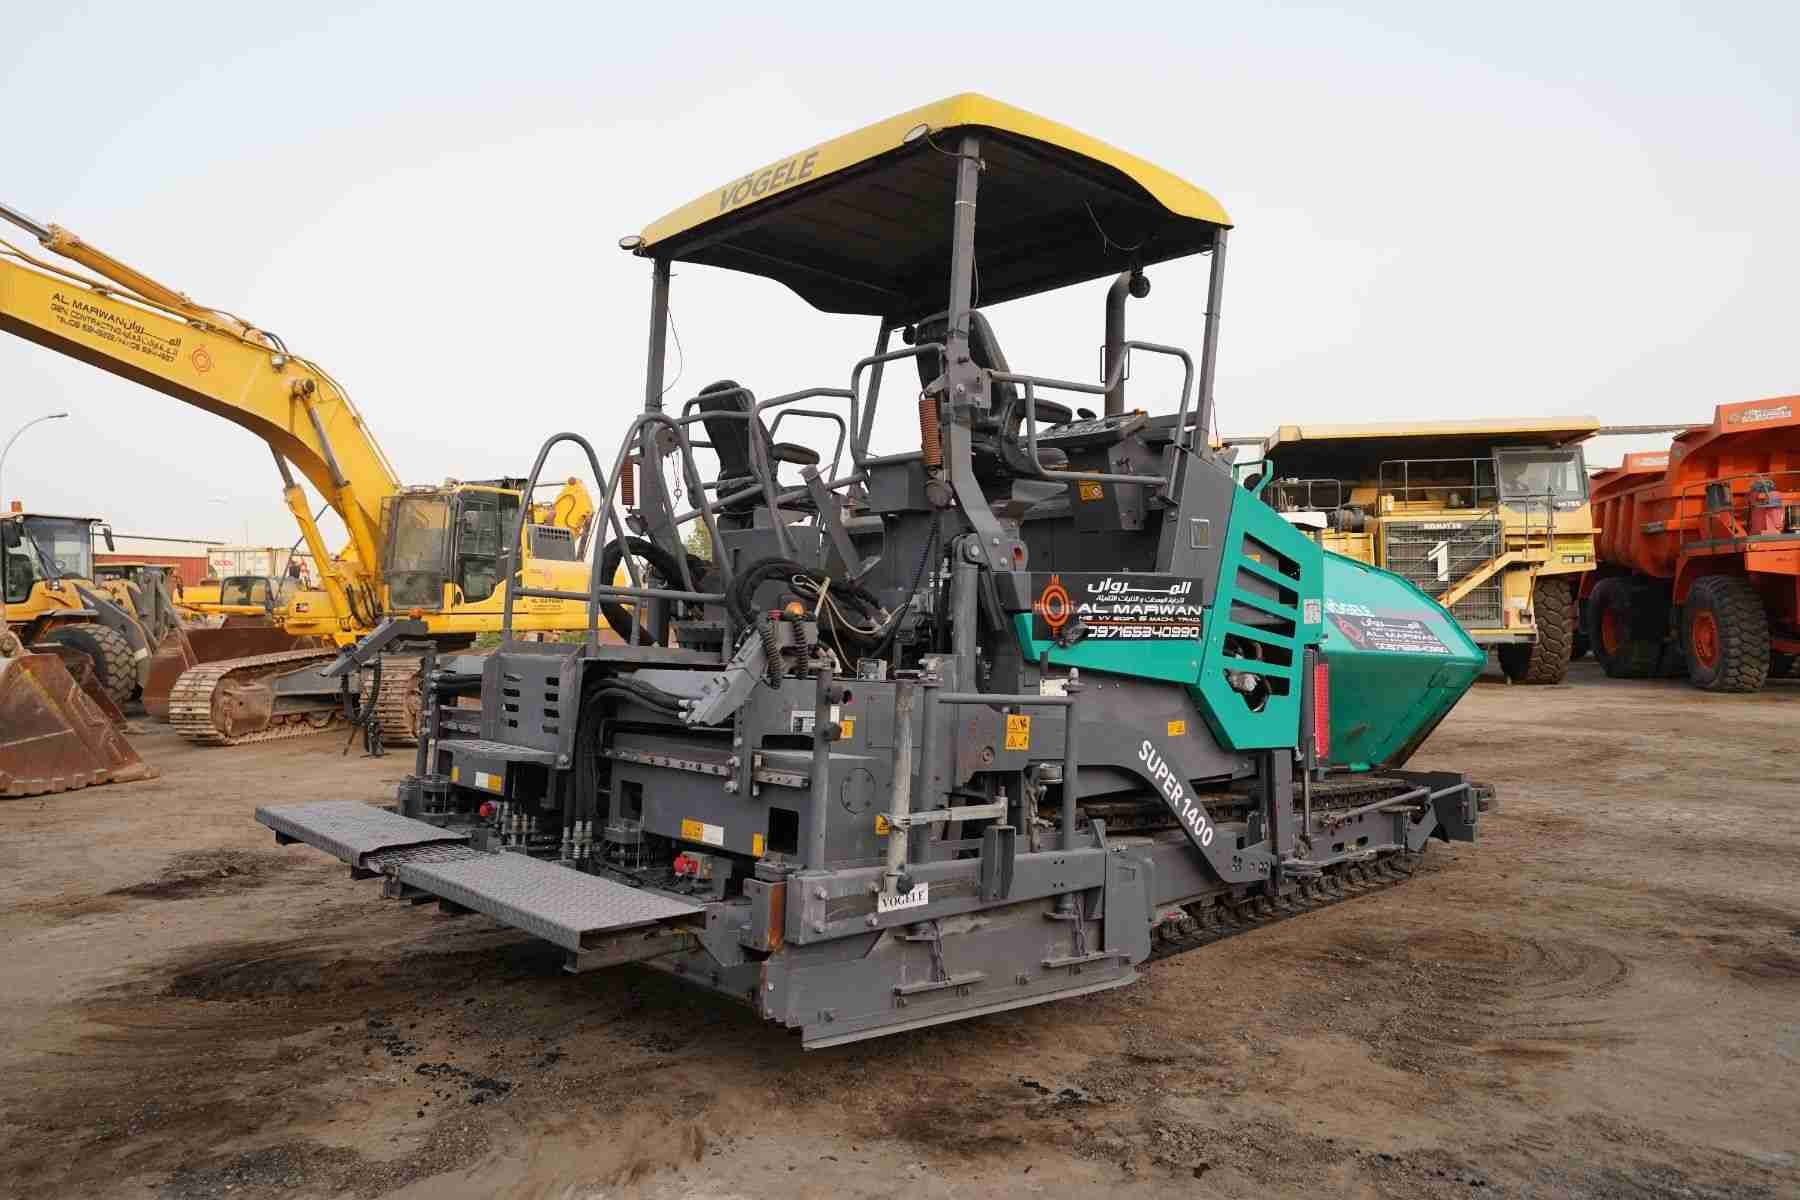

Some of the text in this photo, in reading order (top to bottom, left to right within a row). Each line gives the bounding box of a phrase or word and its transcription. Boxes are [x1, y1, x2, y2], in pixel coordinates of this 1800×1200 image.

[720, 151, 817, 210] VÖGELE
[51, 292, 125, 325] AL MARWAN
[1428, 540, 1449, 582] 1
[1077, 603, 1108, 614] AL
[1113, 604, 1202, 616] MARWAN
[1139, 740, 1214, 847] SUPER 1400
